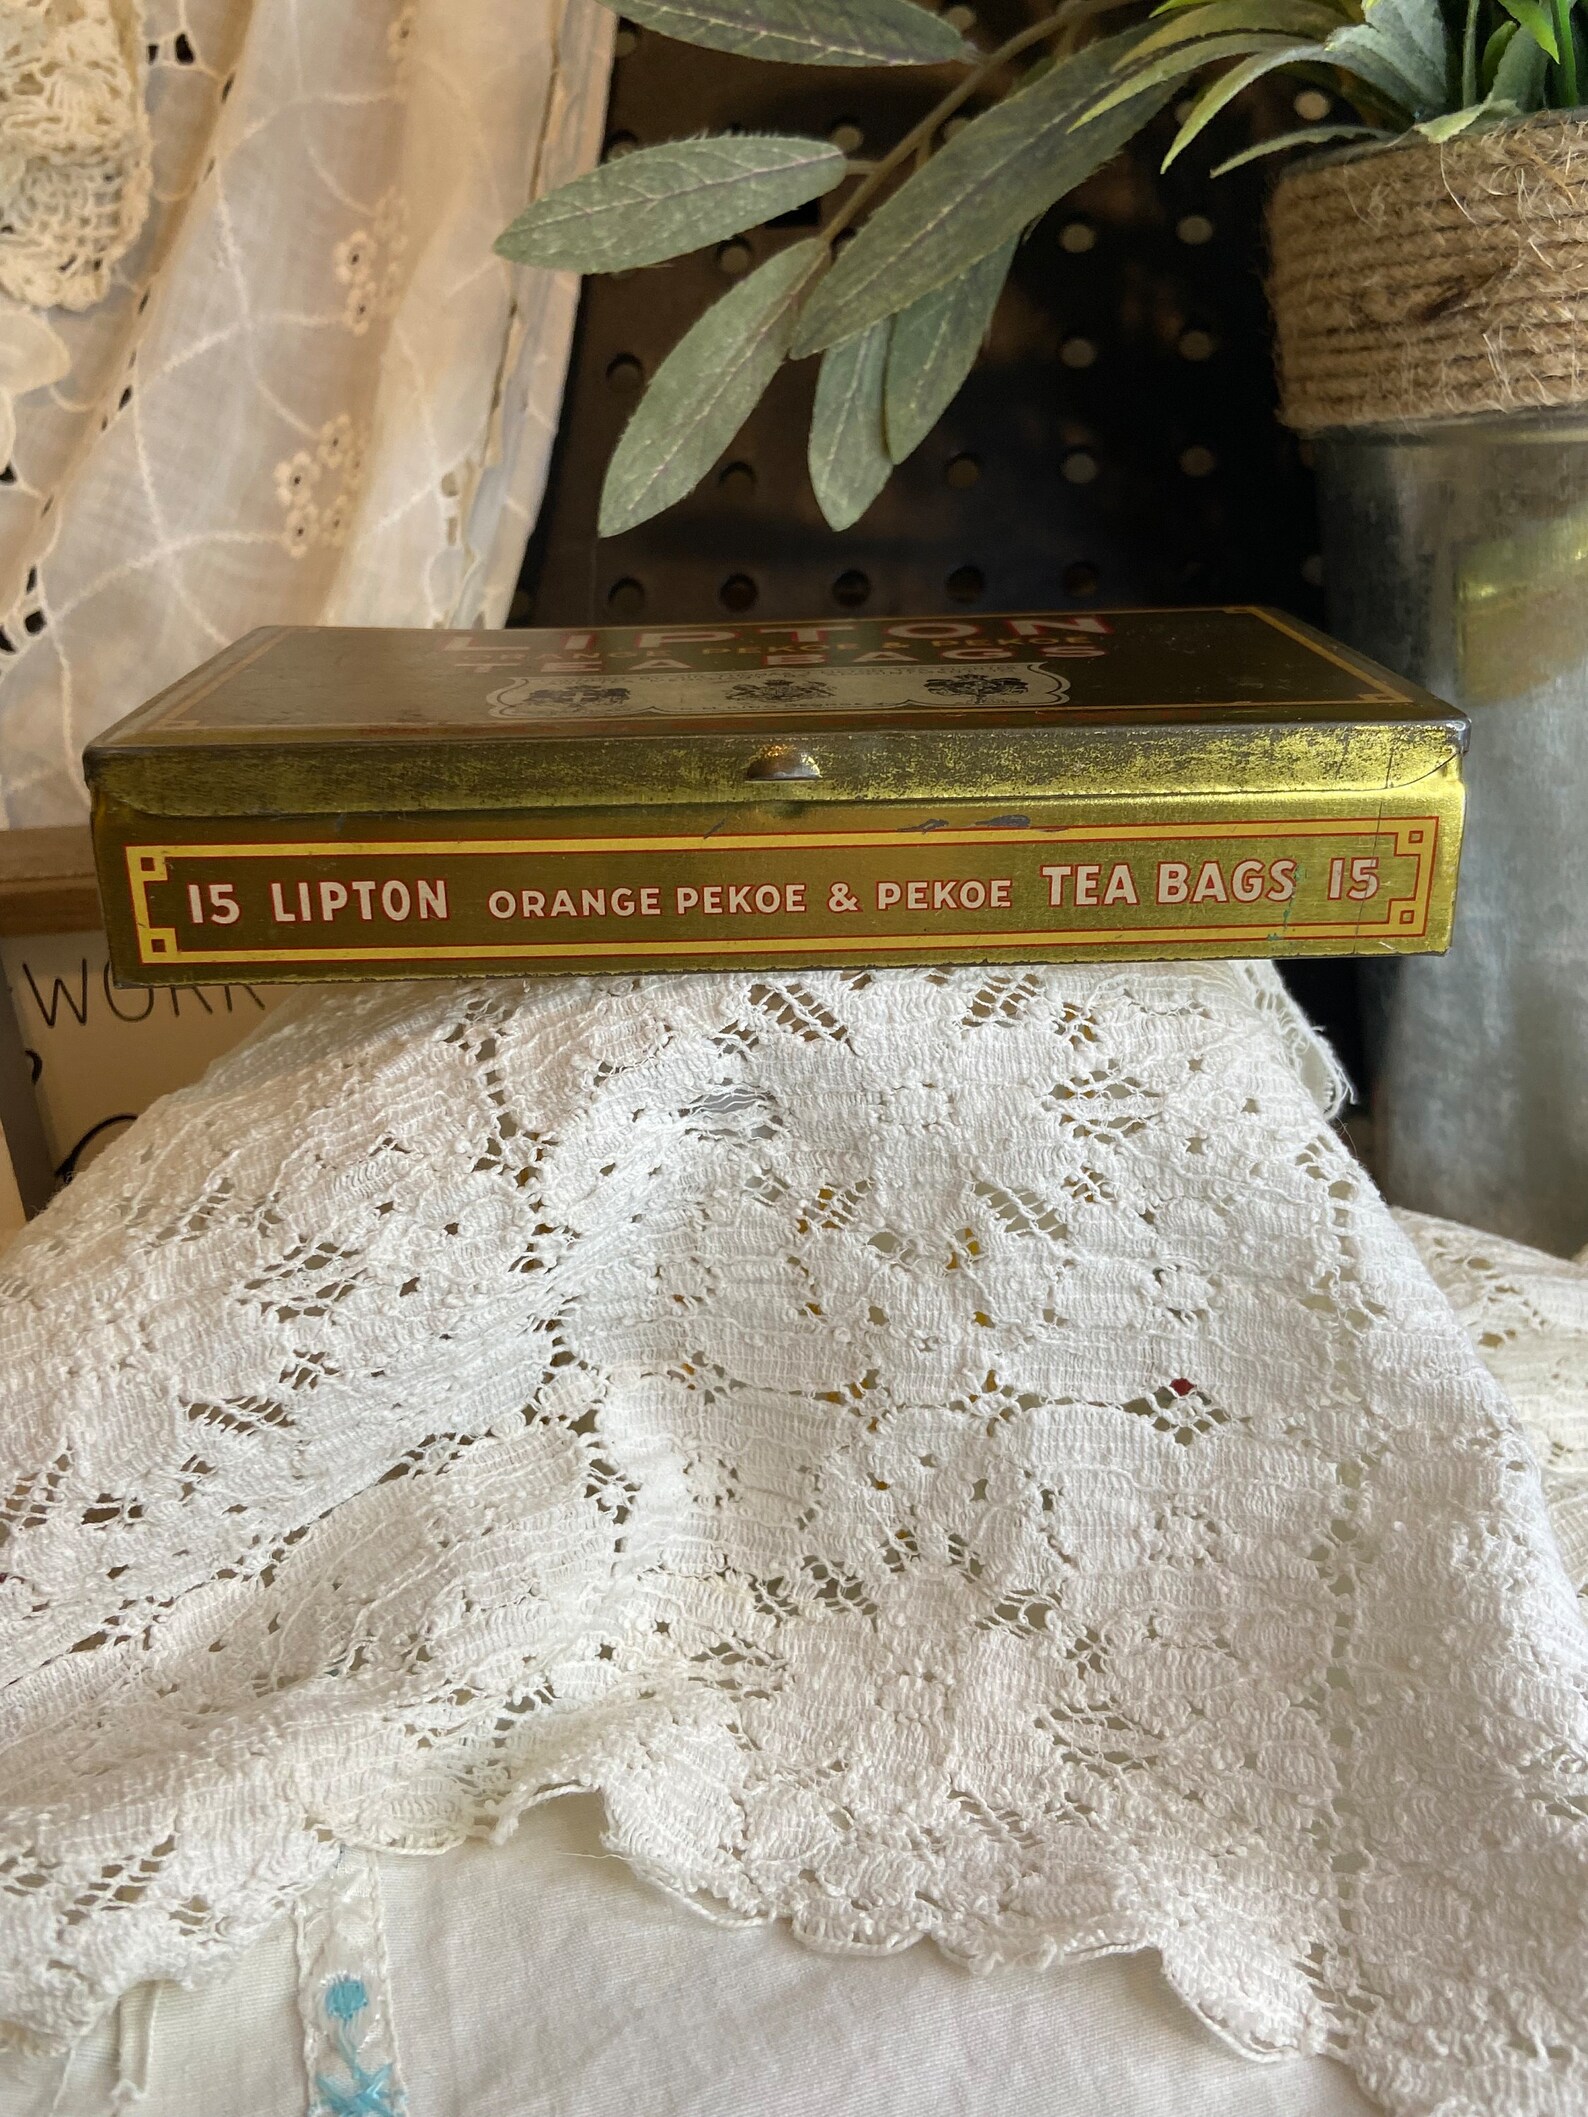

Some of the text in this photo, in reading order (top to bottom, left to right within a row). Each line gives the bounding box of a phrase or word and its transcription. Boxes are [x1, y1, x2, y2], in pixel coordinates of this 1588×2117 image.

[445, 616, 1109, 651] LIPTON
[462, 635, 1093, 661] ORANGE PEKOE & PEKOE
[454, 645, 1107, 673] TEA BAGS
[187, 857, 1381, 925] 15 LIPTON ORANGE PEKOE & PEKOE TEA BAGS 15
